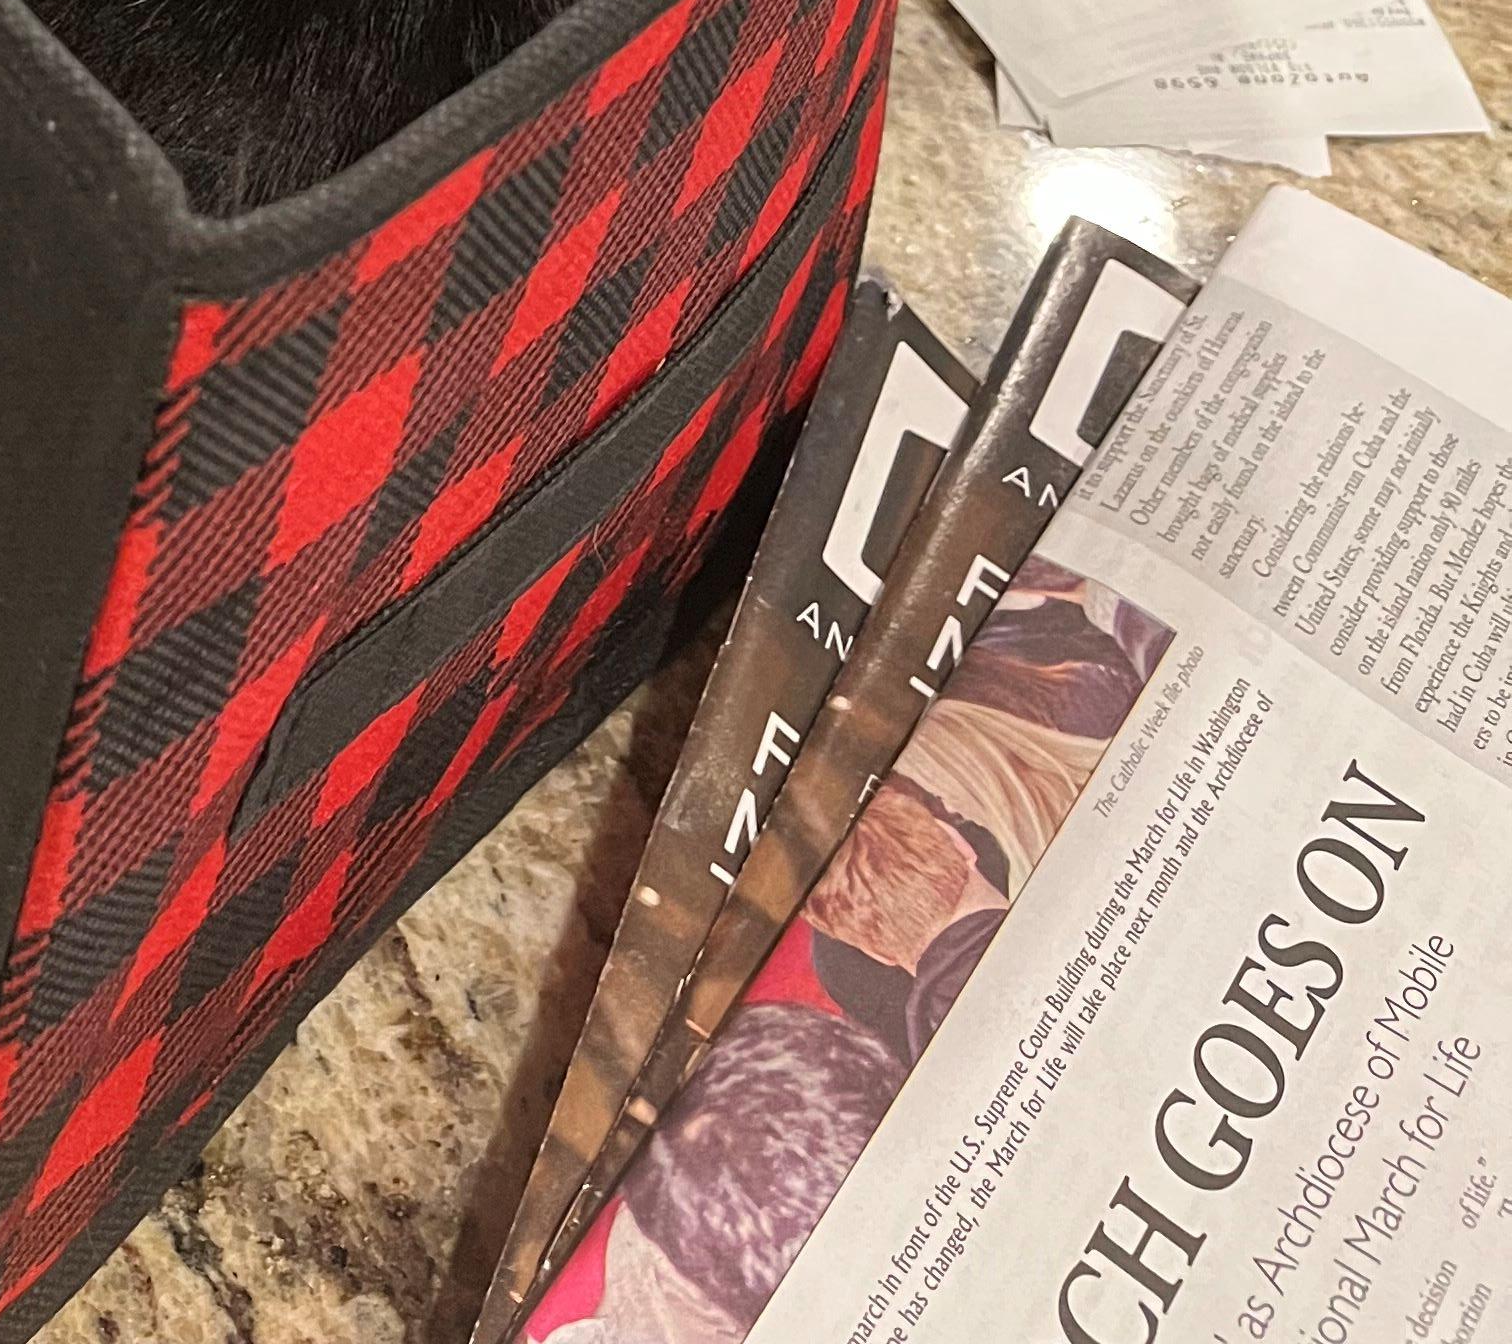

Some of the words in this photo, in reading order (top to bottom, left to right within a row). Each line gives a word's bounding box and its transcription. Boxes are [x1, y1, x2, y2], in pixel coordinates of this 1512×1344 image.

[1196, 348, 1215, 372] of
[1295, 369, 1314, 385] to
[1302, 348, 1326, 370] the
[1073, 488, 1095, 501] it
[1084, 472, 1103, 489] to
[1095, 423, 1137, 473] support
[1122, 403, 1149, 424] the
[1177, 325, 1197, 345] of
[1200, 393, 1227, 416] the
[1269, 379, 1305, 423] island
[1387, 388, 1412, 411] the
[1147, 422, 1172, 444] the
[1194, 408, 1214, 431] of
[1258, 419, 1284, 443] the
[1378, 405, 1401, 436] and
[1397, 405, 1442, 457] initially
[1139, 444, 1159, 463] on
[1155, 490, 1203, 544] brought
[1187, 461, 1223, 492] bags
[1211, 439, 1231, 463] of
[1222, 395, 1260, 448] medical
[1250, 352, 1288, 401] supplies
[1159, 430, 1203, 488] members
[1251, 442, 1271, 462] on
[1352, 434, 1387, 470] Cuba
[1390, 453, 1412, 480] not
[1428, 432, 1460, 469] those
[1098, 462, 1146, 513] Lazarus
[1221, 456, 1259, 500] found
[1251, 497, 1317, 578] Considering
[1299, 475, 1325, 499] the
[1316, 422, 1356, 478] relations
[1340, 401, 1366, 425] be-
[1373, 476, 1402, 509] may
[1422, 468, 1440, 485] to
[1454, 458, 1482, 497] miles
[1128, 485, 1167, 526] Other
[1206, 496, 1240, 536] easily
[1396, 482, 1433, 535] support
[1439, 491, 1463, 514] 90
[1471, 479, 1508, 521] hopes
[1292, 470, 1366, 575] Communist-run
[1353, 507, 1382, 545] some
[1429, 510, 1459, 544] only
[1190, 534, 1214, 562] not
[1442, 518, 1487, 576] Mendez
[1495, 527, 1512, 560] and
[1322, 544, 1365, 588] States,
[1361, 531, 1411, 603] providing
[1405, 543, 1438, 588] nation
[1271, 575, 1306, 618] tween
[1428, 572, 1458, 603] But
[1459, 558, 1503, 615] Knights
[1294, 582, 1337, 636] United
[1329, 595, 1369, 657] consider
[1377, 582, 1413, 631] island
[1448, 613, 1475, 639] the
[1364, 628, 1390, 655] the
[1398, 604, 1444, 658] Florida.
[1487, 611, 1511, 644] will
[1357, 654, 1377, 676] on
[1380, 657, 1414, 695] from
[1414, 638, 1461, 714] experience
[1462, 644, 1497, 683] Cuba
[1452, 685, 1477, 703] in
[1486, 688, 1512, 710] be
[1092, 791, 1119, 819] The
[1110, 737, 1150, 792] Catholic
[1140, 701, 1172, 740] Week
[1161, 682, 1183, 705] file
[1176, 645, 1205, 689] photo
[1191, 677, 1251, 756] Washington
[1436, 697, 1467, 734] had
[1483, 709, 1501, 727] to
[1472, 726, 1493, 750] ers
[1183, 756, 1206, 775] in
[1167, 772, 1197, 802] Life
[1154, 798, 1180, 826] for
[1125, 823, 1167, 874] March
[1113, 872, 1139, 901] the
[1084, 897, 1126, 950] during
[1044, 947, 1097, 1014] Building
[1154, 913, 1344, 1191] GOES
[1296, 758, 1426, 925] ON
[1373, 935, 1454, 1042] Mobile
[897, 1291, 929, 1327] has
[923, 1211, 980, 1291] changed,
[970, 1178, 997, 1210] the
[984, 1120, 1031, 1178] March
[1020, 1089, 1046, 1120] for
[1035, 1057, 1067, 1092] Life
[1060, 1020, 1086, 1055] will
[1077, 988, 1107, 1025] take
[1100, 945, 1132, 991] place
[1124, 907, 1154, 945] next
[1146, 857, 1183, 909] month
[1175, 822, 1199, 857] and
[1190, 799, 1215, 826] the
[1206, 713, 1264, 801] Archdiocese
[1256, 689, 1274, 713] of
[1018, 1010, 1058, 1060] Court
[1365, 1030, 1401, 1080] of
[1423, 1037, 1481, 1098] Life
[974, 1060, 1029, 1135] Supreme
[1398, 1095, 1449, 1151] for
[949, 1135, 985, 1174] U.S.
[934, 1175, 961, 1206] the
[1252, 1085, 1380, 1297] Archdiocese
[923, 1198, 943, 1227] of
[1342, 1155, 1427, 1266] March
[1458, 1197, 1481, 1230] of
[891, 1225, 931, 1274] front
[877, 1273, 902, 1296] in
[1404, 1259, 1458, 1339] decision
[1237, 1295, 1275, 1340] as
